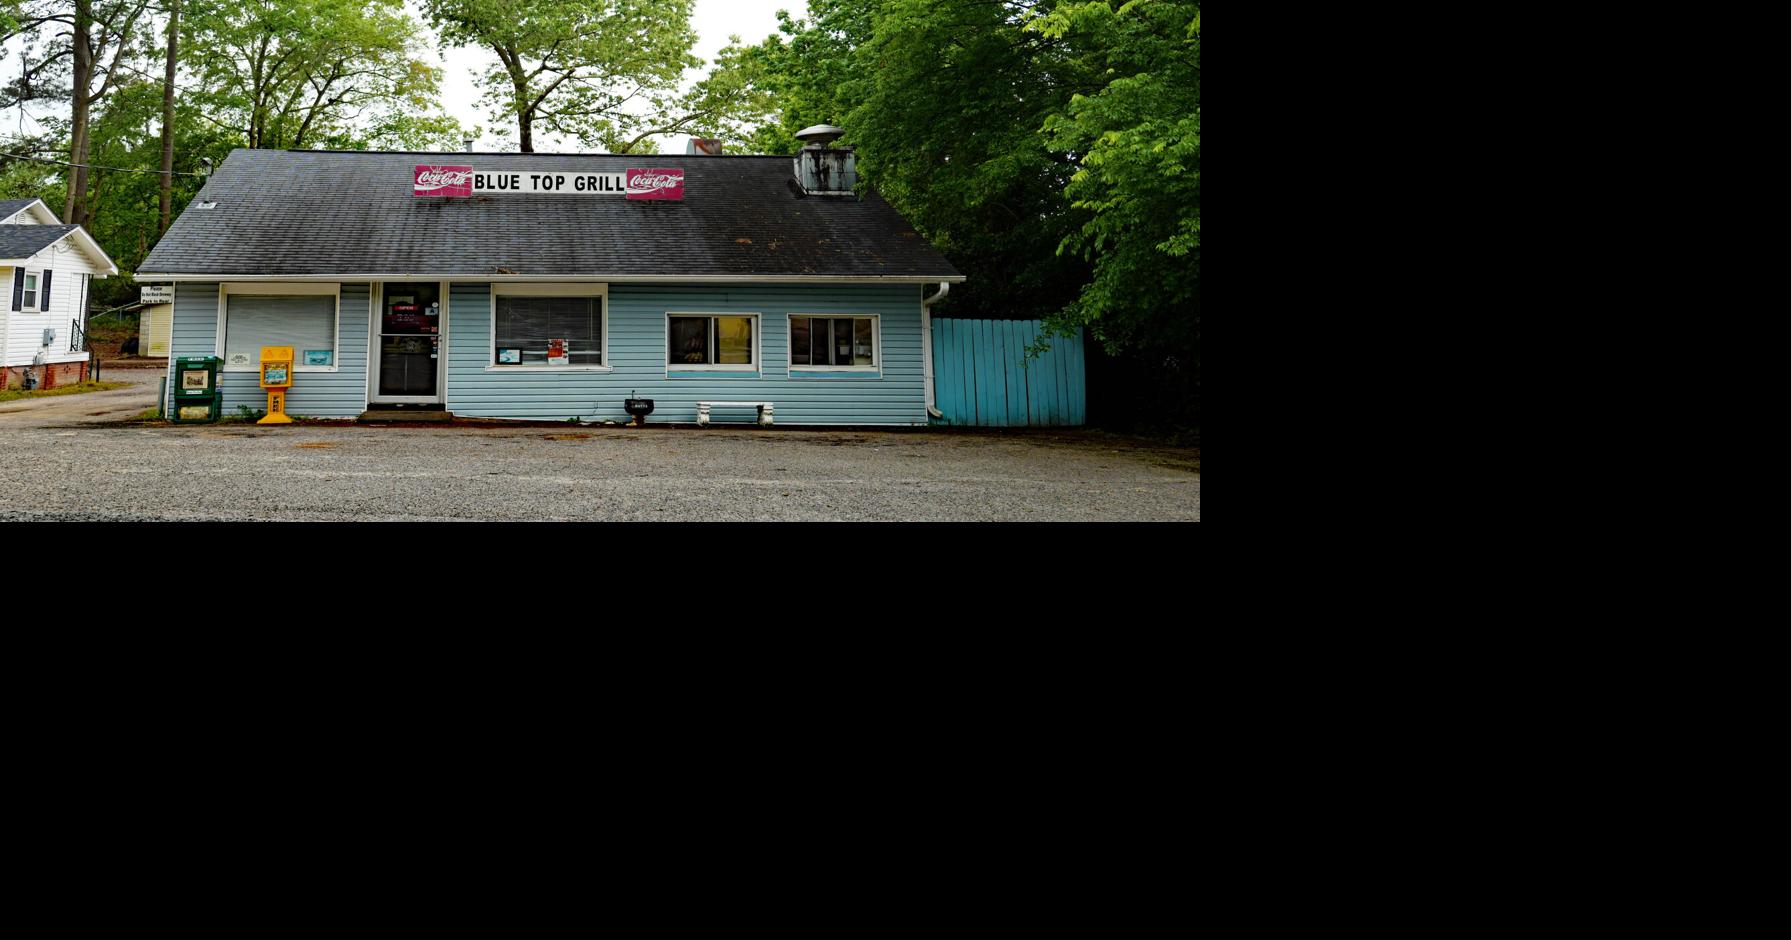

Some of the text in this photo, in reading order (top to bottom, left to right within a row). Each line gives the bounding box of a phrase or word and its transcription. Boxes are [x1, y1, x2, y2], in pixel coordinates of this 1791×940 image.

[418, 170, 467, 186] Coca-Cola
[474, 174, 625, 191] BLUE TOP GRILL
[630, 174, 677, 188] Coca-Cola
